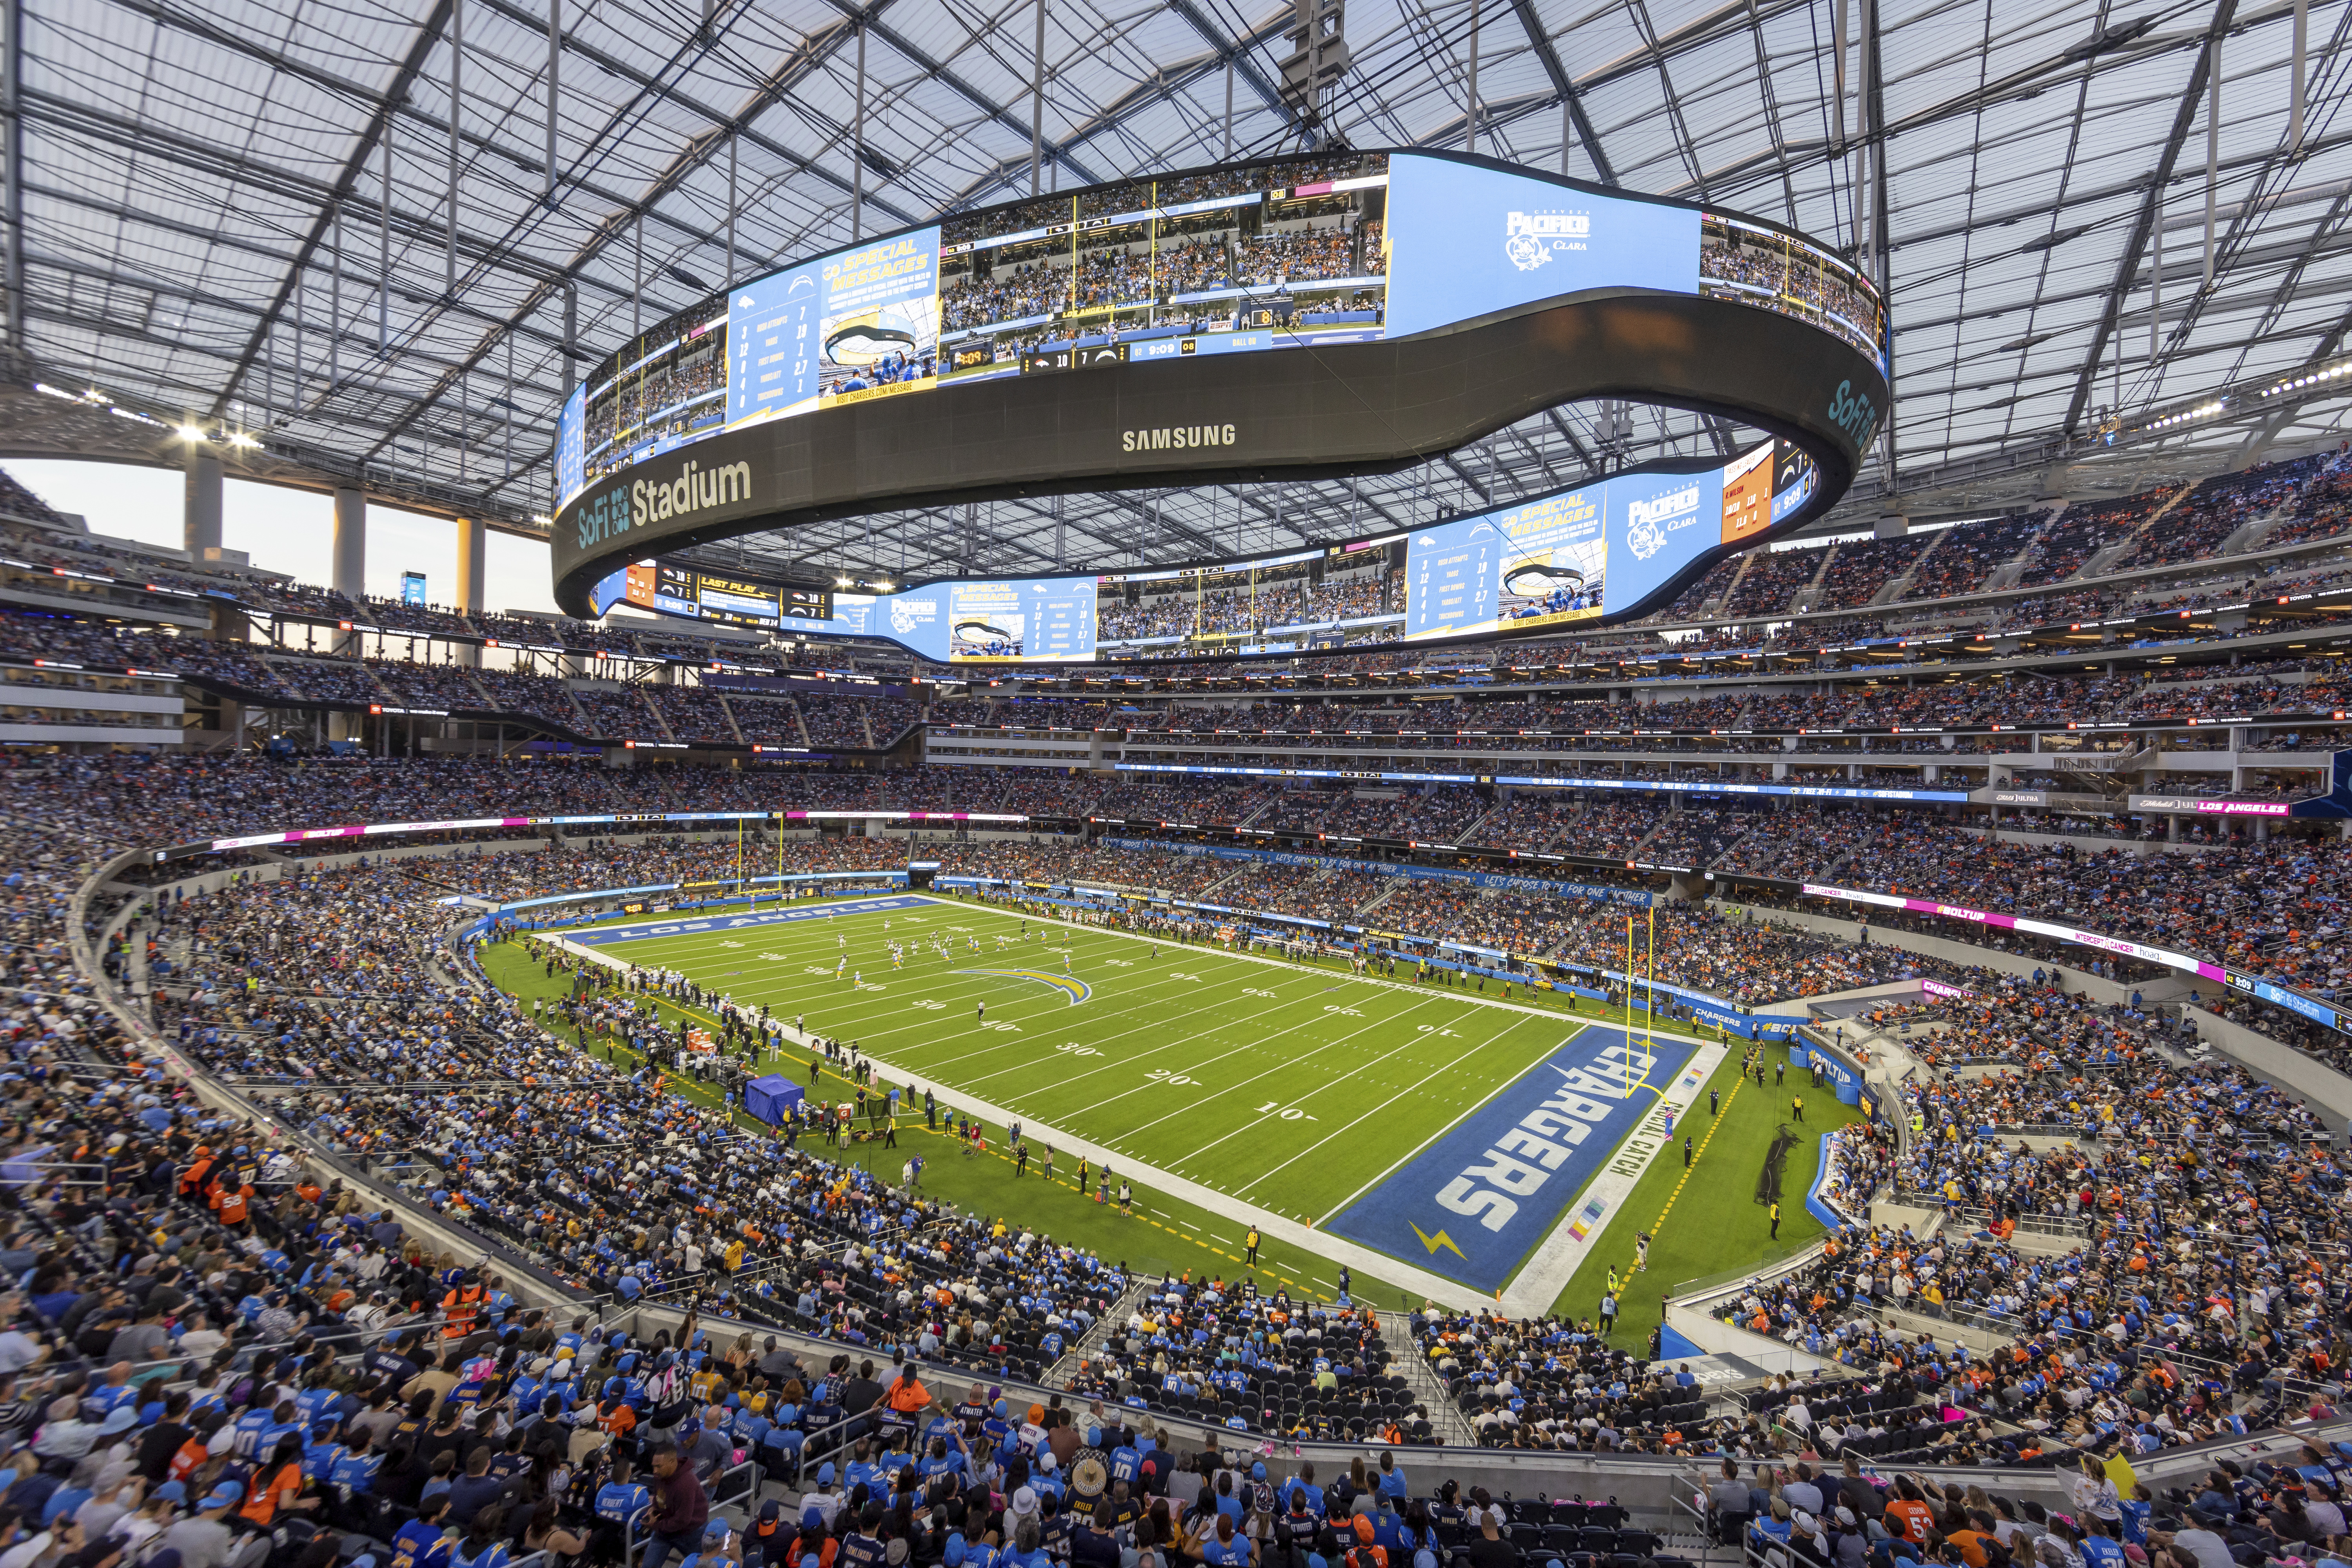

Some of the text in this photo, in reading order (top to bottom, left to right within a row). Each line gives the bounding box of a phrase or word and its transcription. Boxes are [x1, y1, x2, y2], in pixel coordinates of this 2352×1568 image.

[1506, 211, 1590, 236] PACIFICO
[1553, 240, 1587, 250] CLARA
[843, 239, 916, 272] SPECIAL
[831, 254, 929, 292] MESSAGES
[800, 306, 806, 321] 7
[1079, 304, 1115, 317] ANGELES
[1116, 298, 1159, 309] CHARGERS
[797, 323, 807, 339] 19
[1210, 321, 1232, 330] ESPN
[739, 342, 749, 357] 12
[798, 343, 803, 356] 1
[1149, 343, 1174, 355] 9:09
[1232, 338, 1246, 347] BALL
[1058, 352, 1087, 367] 10 7
[794, 359, 808, 376] 2.7
[740, 377, 746, 391] 4
[797, 379, 803, 393] 1
[837, 382, 913, 404] VISIT CHARGERS.COM/MESSAGE
[1829, 380, 1869, 437] SoFi
[1123, 424, 1235, 451] SAMSUNG
[1651, 480, 1699, 499] CERVEZA
[1726, 485, 1744, 499] R.WILSON
[579, 460, 751, 549] SoFi Stadium
[1784, 486, 1800, 509] 9:09
[1520, 494, 1585, 522] SPECIAL
[1628, 486, 1700, 527] PACIFICO
[1509, 504, 1596, 537] MESSAGES
[1667, 516, 1697, 531] CLARA
[1422, 559, 1428, 570] 3
[1448, 554, 1468, 564] ATTEMPTS
[1480, 548, 1486, 559] 7
[676, 571, 685, 582] 10
[1419, 561, 1487, 584] 12 YARDS 19
[701, 577, 757, 593] LAST PLAY
[966, 584, 1011, 592] SPECIAL
[1450, 583, 1465, 591] DOWNS
[1479, 576, 1484, 588] 1
[677, 587, 683, 597] 7
[808, 593, 818, 603] 10
[958, 593, 1018, 601] MESSAGES
[664, 600, 682, 610] 9:09
[1421, 600, 1426, 610] 4
[1475, 590, 1488, 603] 2.7
[810, 608, 816, 617] 7
[1438, 610, 1464, 620] TOUCHDOWNS
[1477, 605, 1483, 616] 1
[1514, 610, 1581, 627] VISIT CHARGERS.COM/MESSAGE
[352, 624, 377, 632] TOYOTA
[2199, 802, 2223, 811] LOS
[2225, 802, 2287, 814] ANGELES
[1485, 875, 1504, 887] LET'S
[1507, 877, 1539, 891] CHOOSE
[1567, 884, 1584, 895] FOR
[1587, 887, 1604, 898] ONE
[621, 922, 712, 938] LOS
[728, 901, 902, 927] ANGELES
[1936, 905, 1985, 920] #BOLTUP
[2075, 933, 2104, 945] INTERCEPT
[2111, 941, 2133, 953] CANCER
[1527, 956, 1557, 967] ANGELES
[1558, 962, 1594, 973] CHARGERS
[1286, 964, 1444, 996] INTERCEPT CANCER
[2236, 976, 2251, 990] 9:09
[912, 999, 946, 1010] 50
[2270, 987, 2319, 1018] SoFi Stadium
[1695, 1007, 1741, 1027] CHARGERS
[979, 1020, 1015, 1031] 40
[1055, 1042, 1097, 1056] 30
[1144, 1069, 1192, 1085] 20
[1254, 1101, 1304, 1120] 10
[1435, 1046, 1657, 1232] CHARGERS
[1609, 1136, 1655, 1178] CATCH
[1050, 1341, 1058, 1352] 32
[807, 1414, 829, 1424] TOMLINSON
[960, 1407, 983, 1417] ATWATER
[1117, 1452, 1134, 1463] HERBERT
[930, 1462, 948, 1474] HERBERT
[1114, 1461, 1132, 1480] 10
[1031, 1480, 1055, 1492] TOMLINSON
[1074, 1501, 1093, 1512] EKELER
[846, 1543, 873, 1562] TOMLINSON
